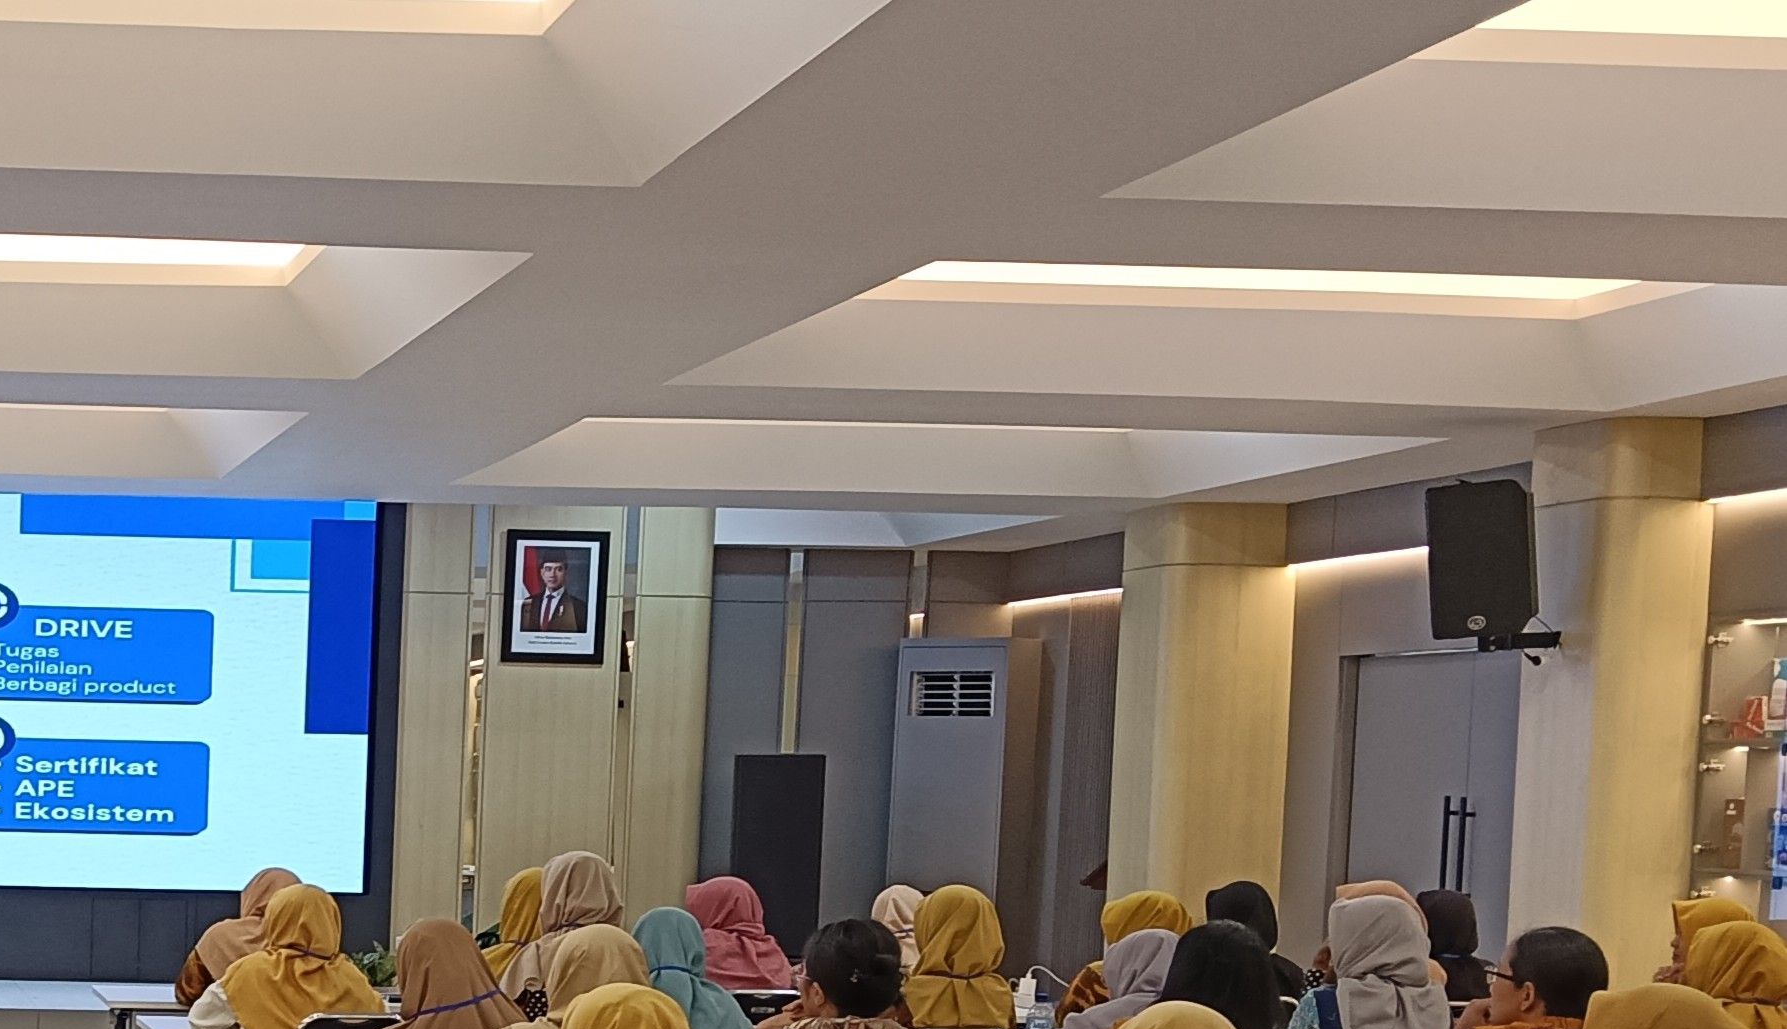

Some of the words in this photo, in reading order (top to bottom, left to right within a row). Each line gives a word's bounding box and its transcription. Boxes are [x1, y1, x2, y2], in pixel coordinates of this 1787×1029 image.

[34, 618, 134, 640] DRIVE
[84, 679, 177, 697] product
[15, 755, 158, 777] Sertifikat
[15, 779, 75, 798] APE
[15, 801, 174, 823] Ekosistem
